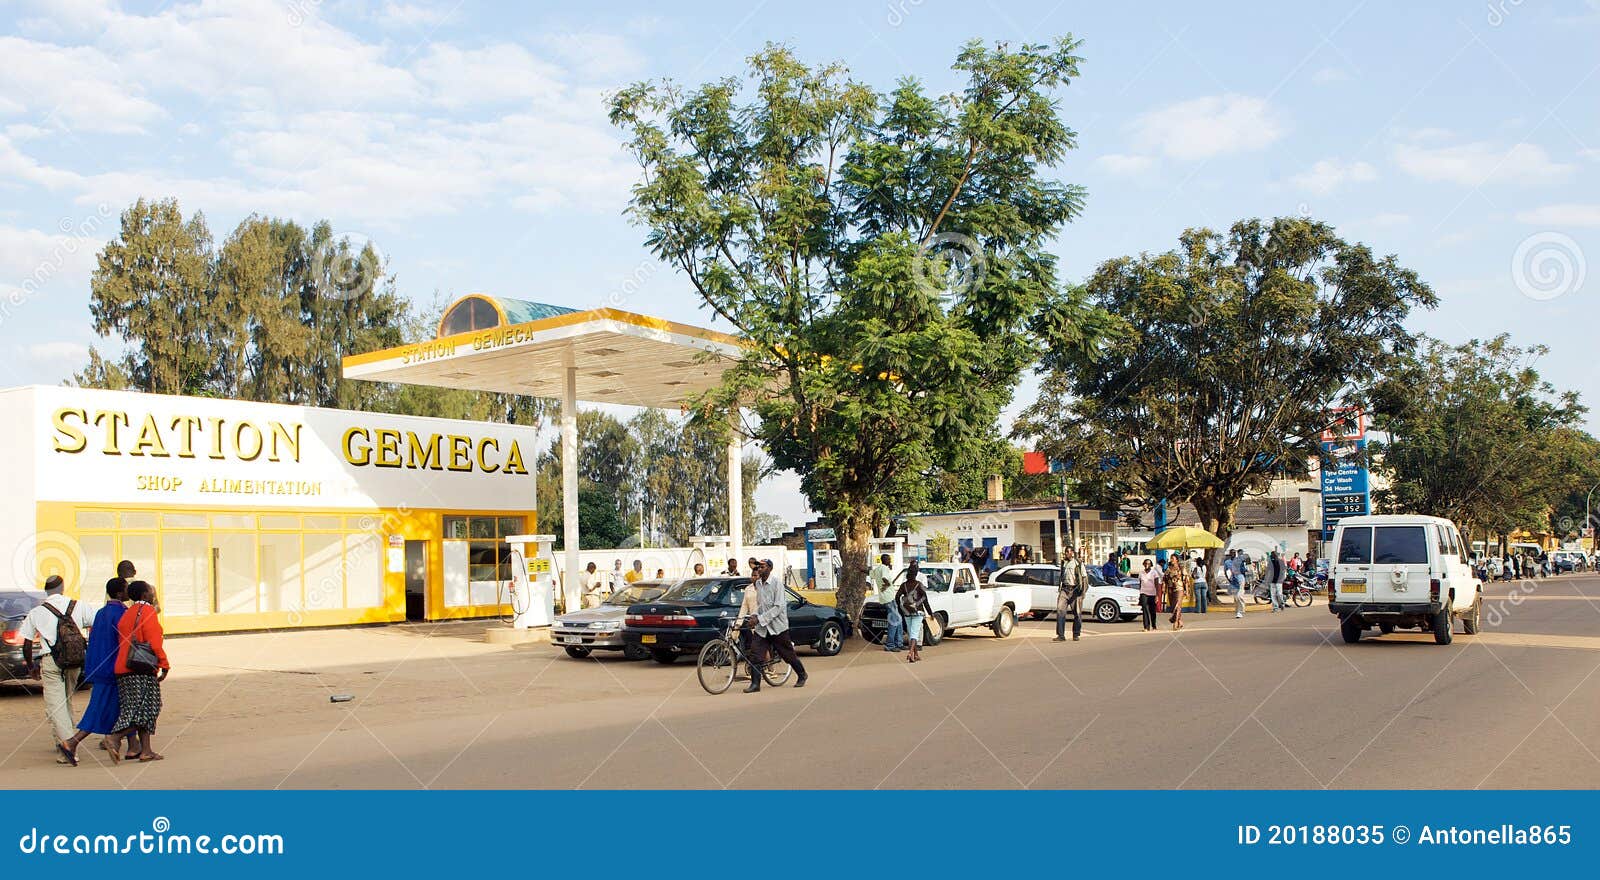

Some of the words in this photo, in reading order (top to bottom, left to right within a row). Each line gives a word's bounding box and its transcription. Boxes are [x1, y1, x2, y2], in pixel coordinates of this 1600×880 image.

[402, 340, 456, 364] STATION
[472, 325, 534, 351] GEMECA
[51, 407, 302, 463] STATION
[341, 426, 529, 475] GEMECA
[136, 474, 183, 492] SHOP
[199, 477, 322, 496] ALIMENTATION
